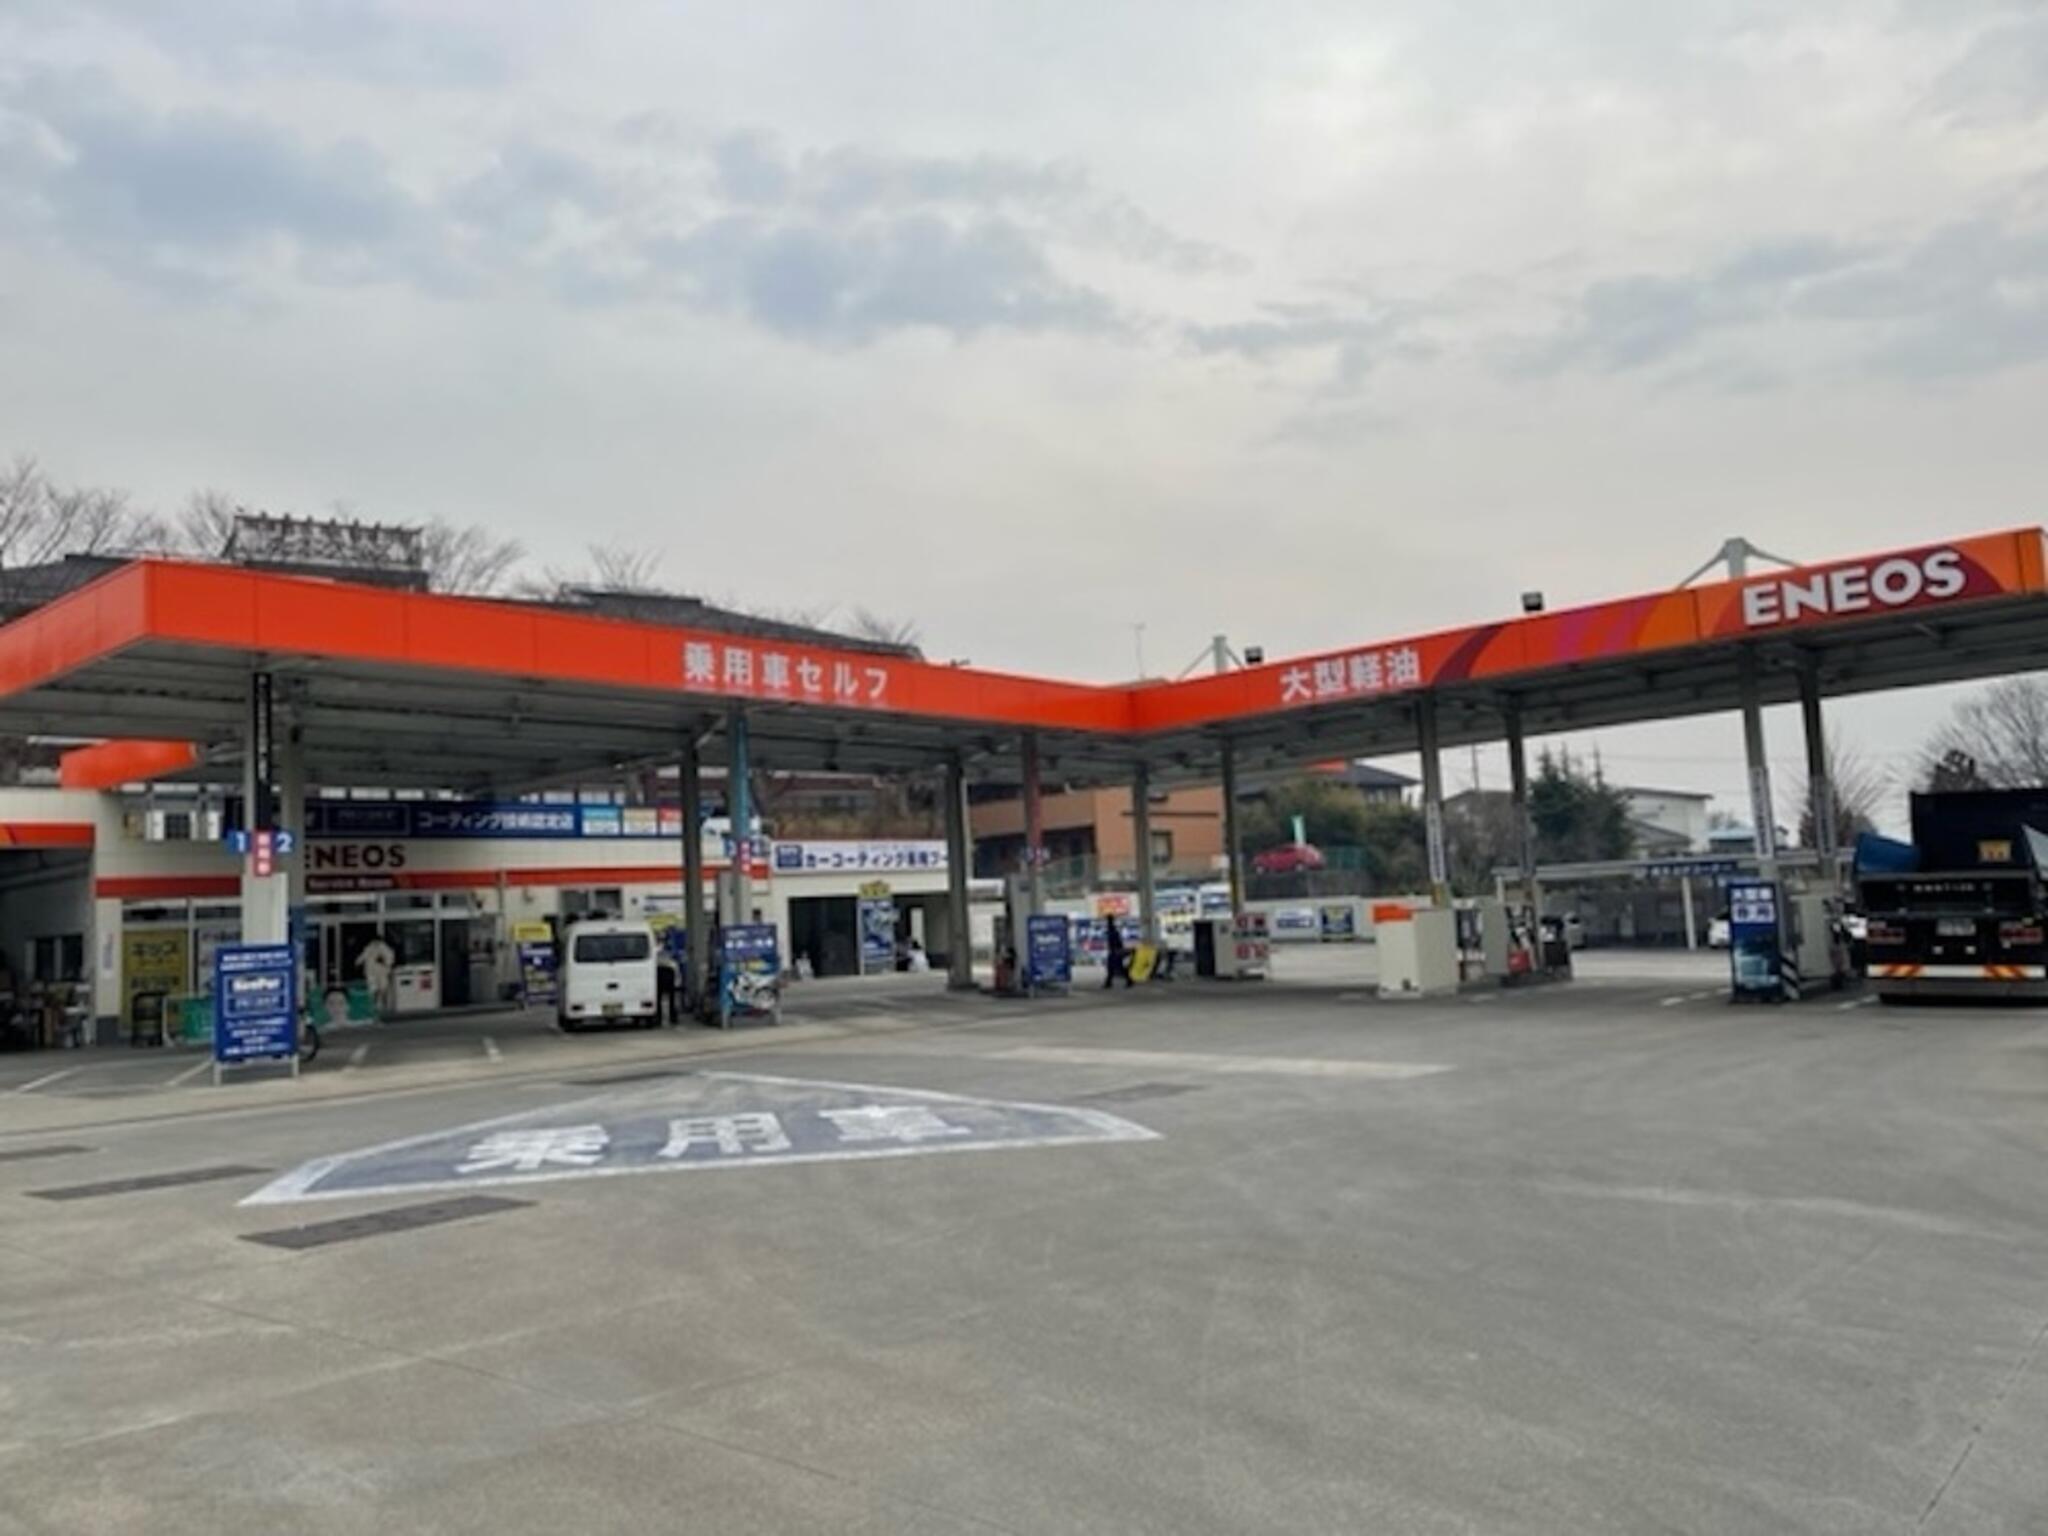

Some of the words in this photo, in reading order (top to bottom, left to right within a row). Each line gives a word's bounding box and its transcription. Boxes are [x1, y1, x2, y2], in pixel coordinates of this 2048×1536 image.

[1741, 551, 1967, 627] ENEOS
[683, 641, 889, 699] 乗用車セルフ
[1279, 647, 1421, 702] 大型軽油
[235, 831, 246, 853] 1
[275, 831, 293, 853] 2
[453, 1104, 973, 1173] 乗用車
